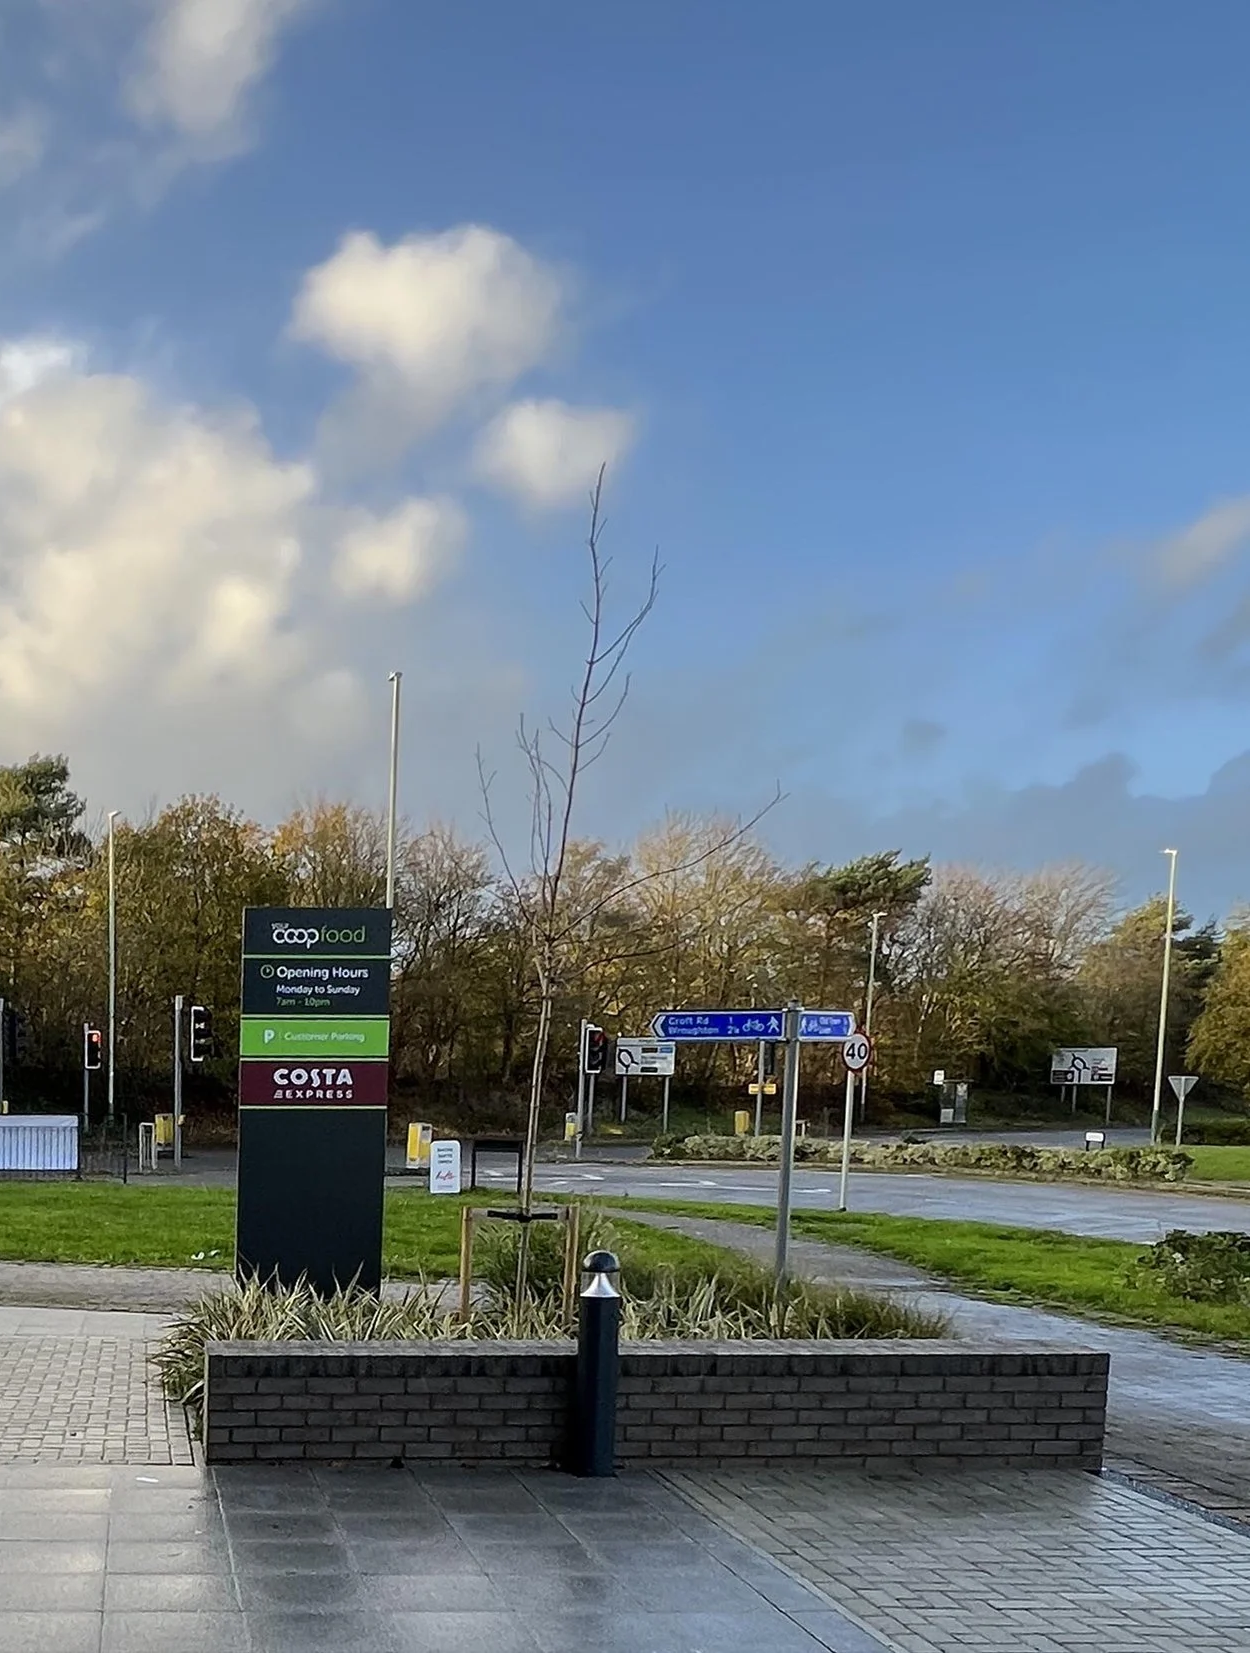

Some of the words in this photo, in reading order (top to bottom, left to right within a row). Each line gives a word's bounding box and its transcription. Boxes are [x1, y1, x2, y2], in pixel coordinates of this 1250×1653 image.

[272, 928, 320, 949] coop
[320, 924, 366, 943] food
[276, 966, 329, 981] Opening
[332, 967, 369, 979] Hours
[276, 985, 313, 996] Monday
[314, 985, 326, 995] to
[327, 985, 361, 996] Sunday
[276, 997, 296, 1006] 7am
[304, 997, 331, 1008] 10pm
[668, 1016, 694, 1025] Croft
[696, 1016, 709, 1025] Rd
[284, 1032, 328, 1041] Customer
[331, 1032, 366, 1043] Parking
[846, 1043, 867, 1059] 40
[273, 1068, 354, 1087] COSTA
[285, 1089, 354, 1099] EXPRESS
